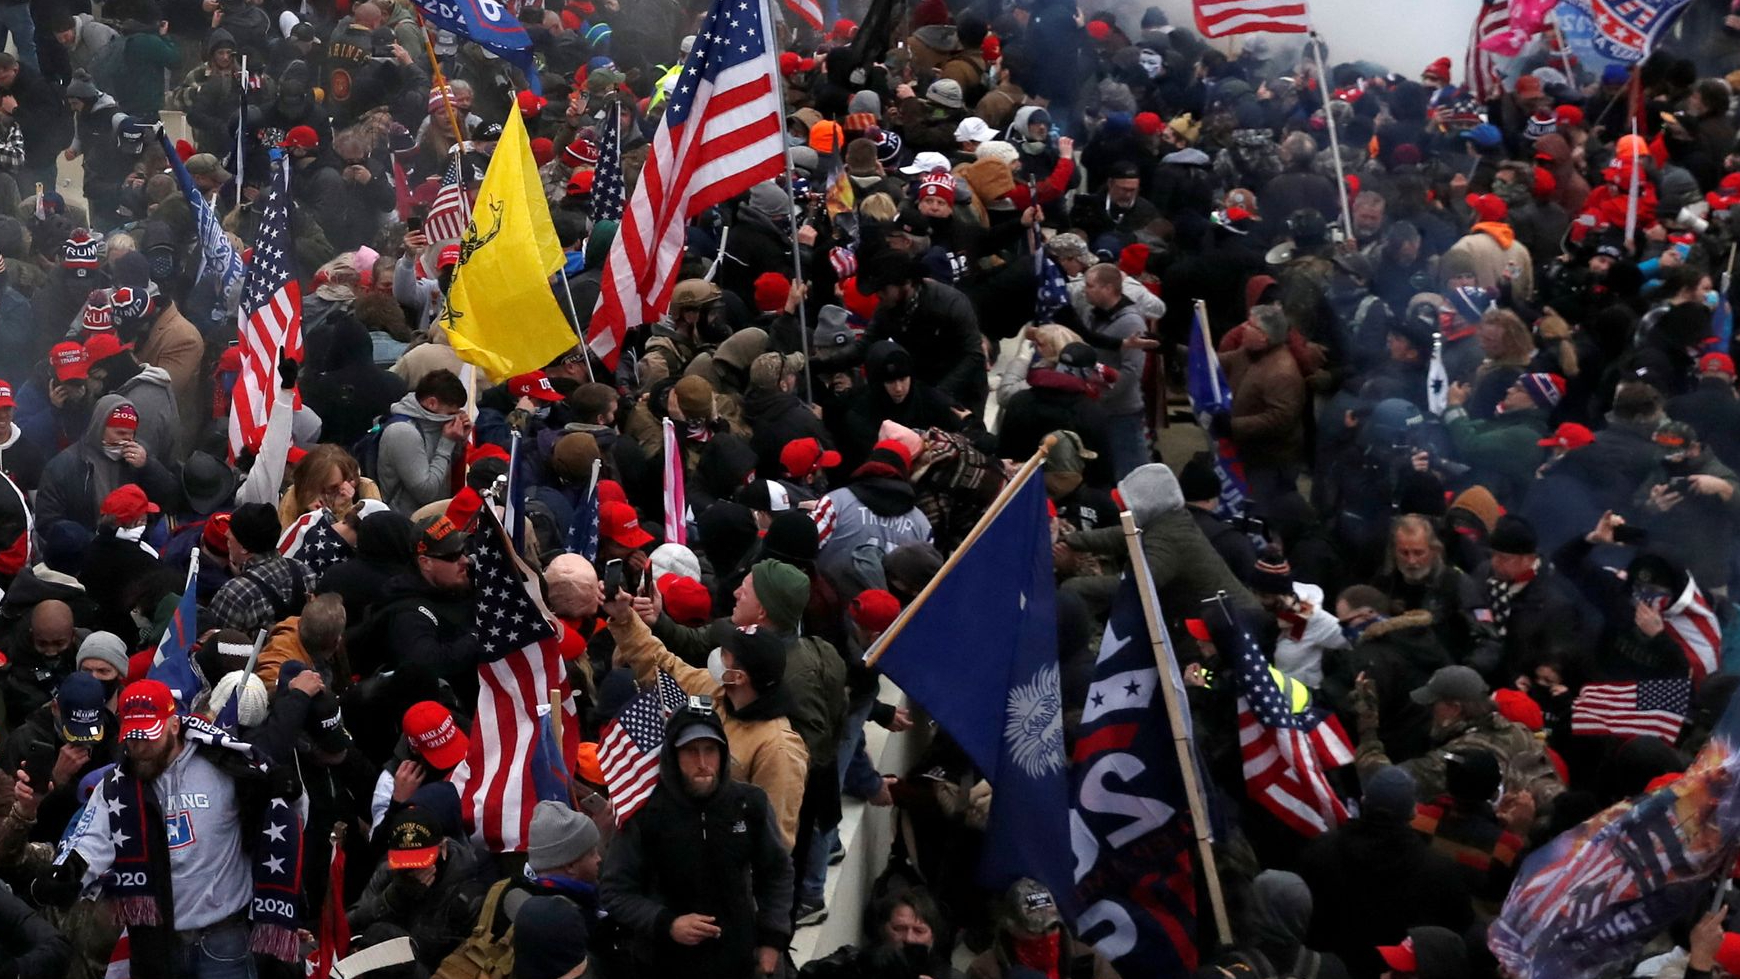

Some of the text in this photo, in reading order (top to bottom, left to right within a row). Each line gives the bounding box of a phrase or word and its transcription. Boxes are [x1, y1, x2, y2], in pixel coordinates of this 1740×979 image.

[857, 506, 914, 535] TRUMP
[72, 709, 99, 718] TRUMP
[254, 897, 294, 919] 2020
